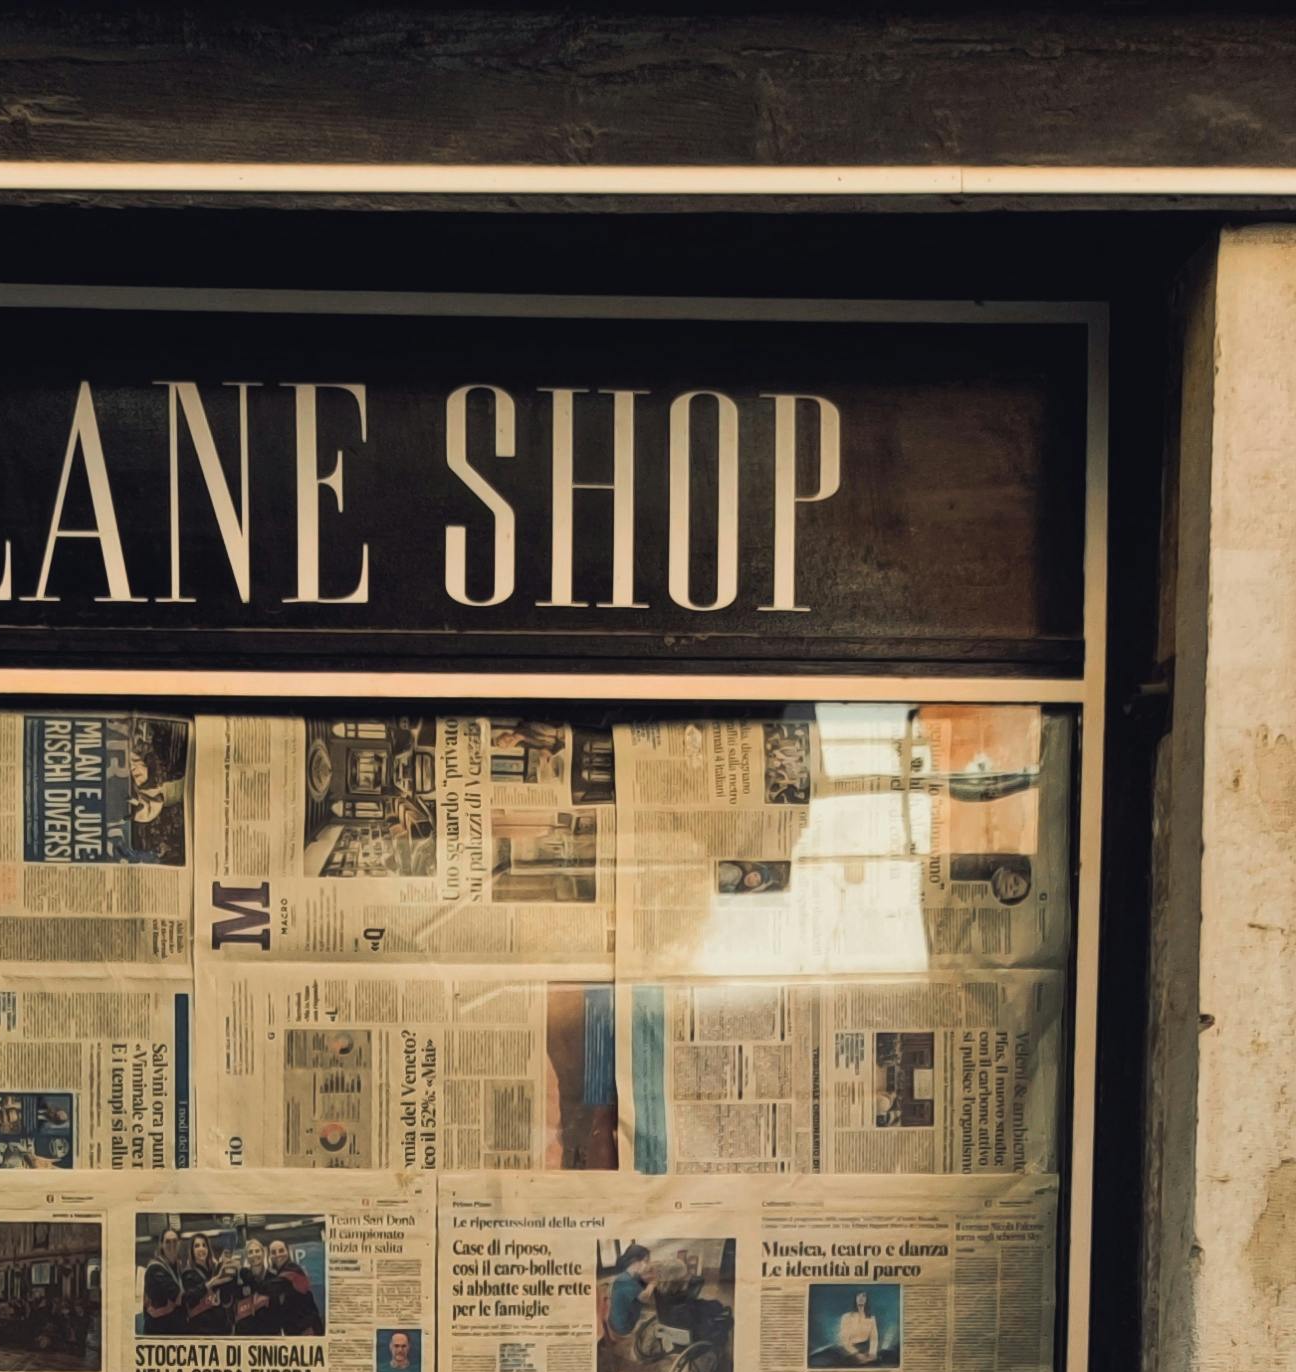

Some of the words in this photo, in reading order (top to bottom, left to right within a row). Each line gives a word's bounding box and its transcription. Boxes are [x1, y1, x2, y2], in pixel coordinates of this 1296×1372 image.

[444, 384, 842, 613] SHOP
[44, 720, 71, 782] RISCHI
[75, 722, 102, 781] MILAN
[75, 788, 102, 800] E
[44, 789, 71, 863] DIVERSI
[75, 806, 102, 859] JUVE:
[212, 881, 270, 951] M
[280, 898, 288, 934] MACRO
[152, 1044, 168, 1097] Salvini
[152, 1100, 163, 1127] ora
[132, 1124, 143, 1136] e
[132, 1137, 144, 1159] tre
[453, 1240, 484, 1255] Case
[487, 1239, 501, 1255] di
[505, 1240, 551, 1258] riposo,
[762, 1242, 826, 1256] Musica,
[831, 1244, 882, 1256] teatro
[886, 1246, 895, 1256] e
[899, 1240, 948, 1256] danza
[762, 1262, 782, 1277] Le
[786, 1261, 850, 1276] identità
[854, 1260, 869, 1276] al
[873, 1266, 921, 1281] parco
[136, 1345, 220, 1366] STOCCATA
[226, 1345, 242, 1367] DI
[248, 1345, 324, 1366] SINIGALIA
